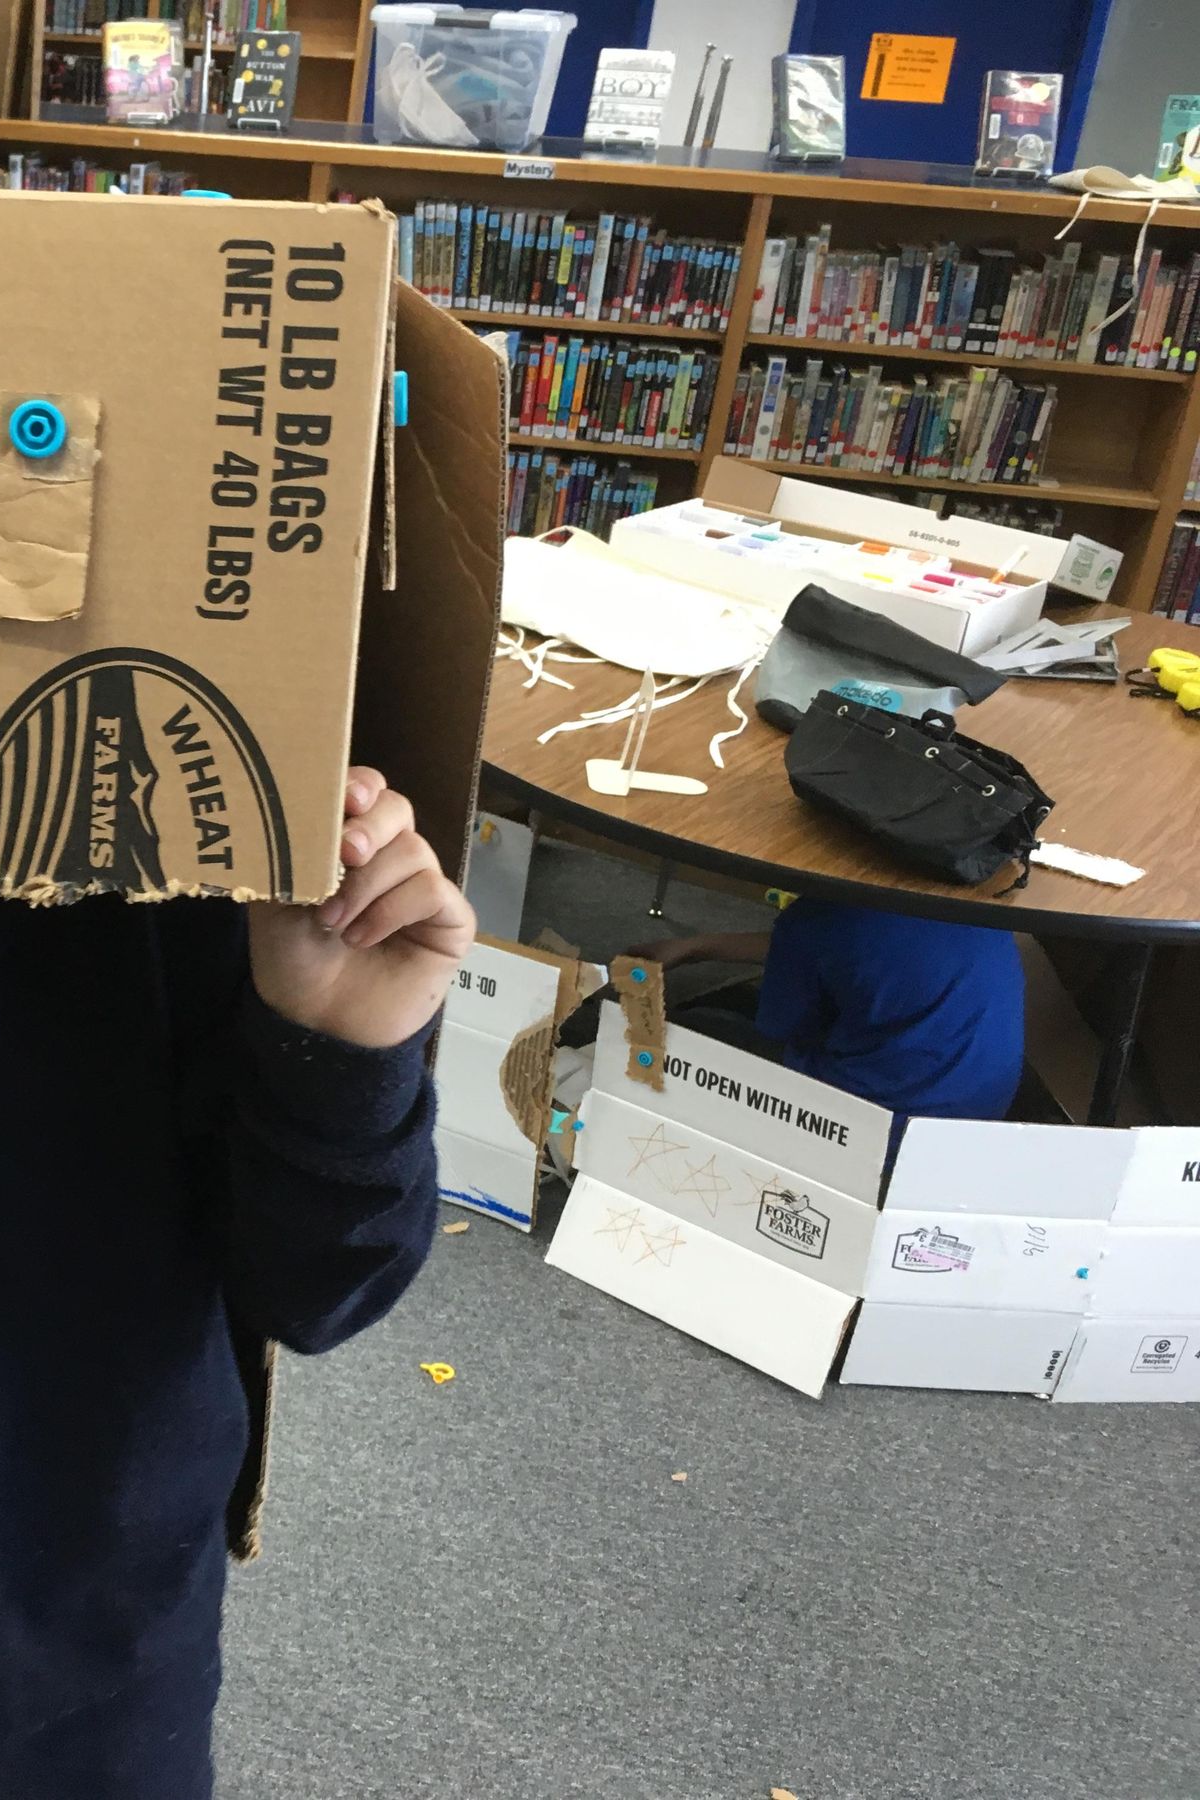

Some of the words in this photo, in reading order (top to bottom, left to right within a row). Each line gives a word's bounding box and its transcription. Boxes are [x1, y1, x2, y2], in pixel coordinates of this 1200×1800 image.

[246, 100, 275, 113] AVI
[506, 163, 554, 178] Mystery
[218, 239, 276, 349] (NET
[285, 241, 346, 302] 10
[280, 325, 340, 390] LB
[216, 365, 267, 437] WT
[210, 450, 259, 508] 40
[267, 413, 332, 554] BAGS
[195, 525, 255, 620] LBS)
[88, 716, 121, 869] FARMS
[161, 703, 234, 870] WHEAT
[695, 1067, 741, 1102] OPEN
[746, 1086, 793, 1123] WITH
[796, 1107, 850, 1147] KNIFE
[764, 1204, 822, 1238] FOSTER
[768, 1217, 814, 1246] FARMS
